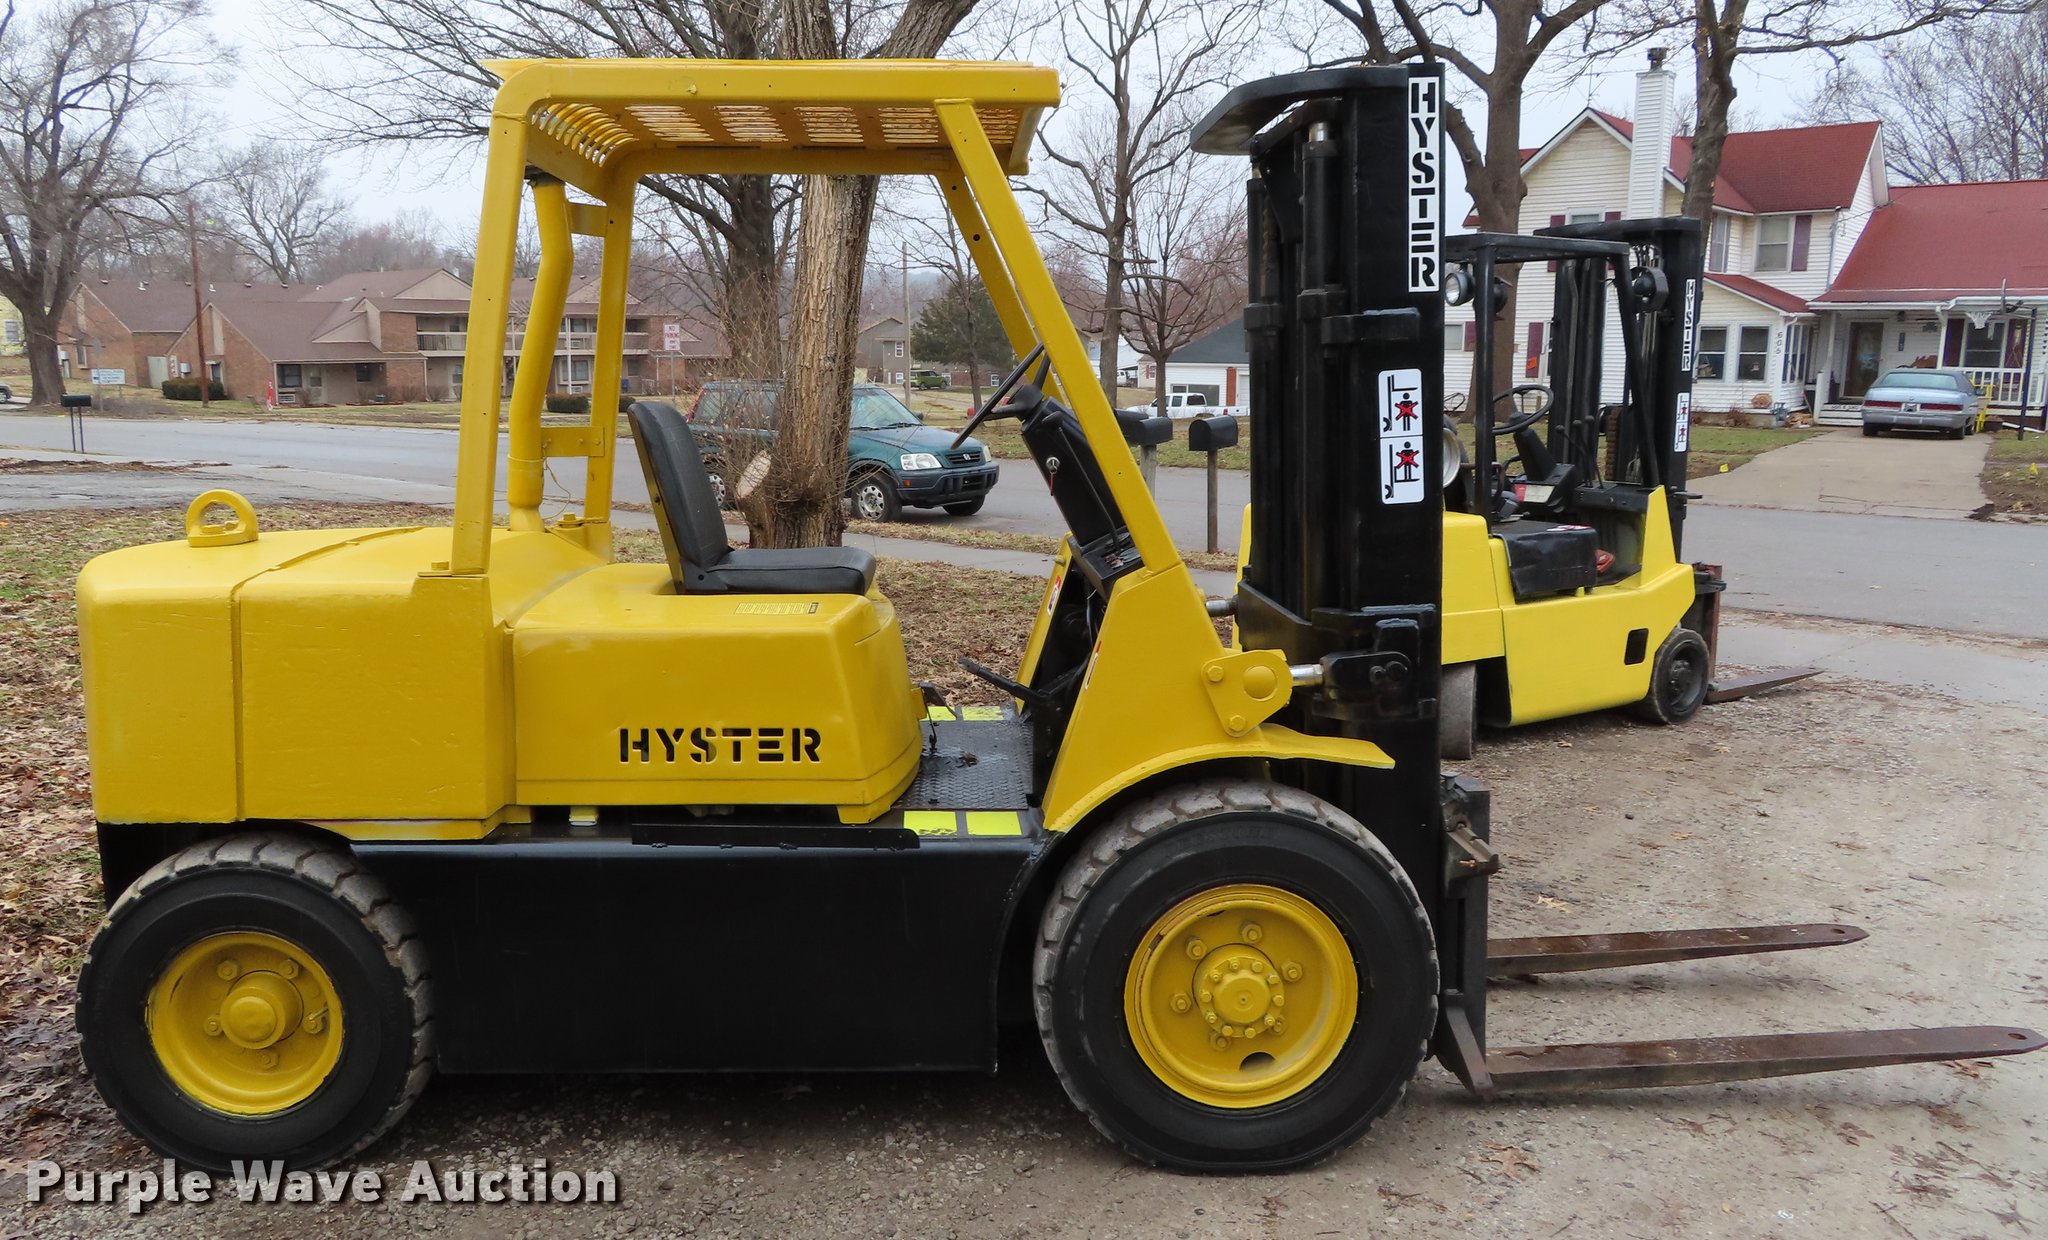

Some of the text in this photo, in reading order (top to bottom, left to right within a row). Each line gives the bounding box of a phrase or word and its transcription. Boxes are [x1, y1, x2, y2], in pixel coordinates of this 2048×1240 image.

[1411, 82, 1436, 288] HYSTER
[1682, 281, 1695, 369] HYSTER
[620, 727, 821, 763] HYSTER
